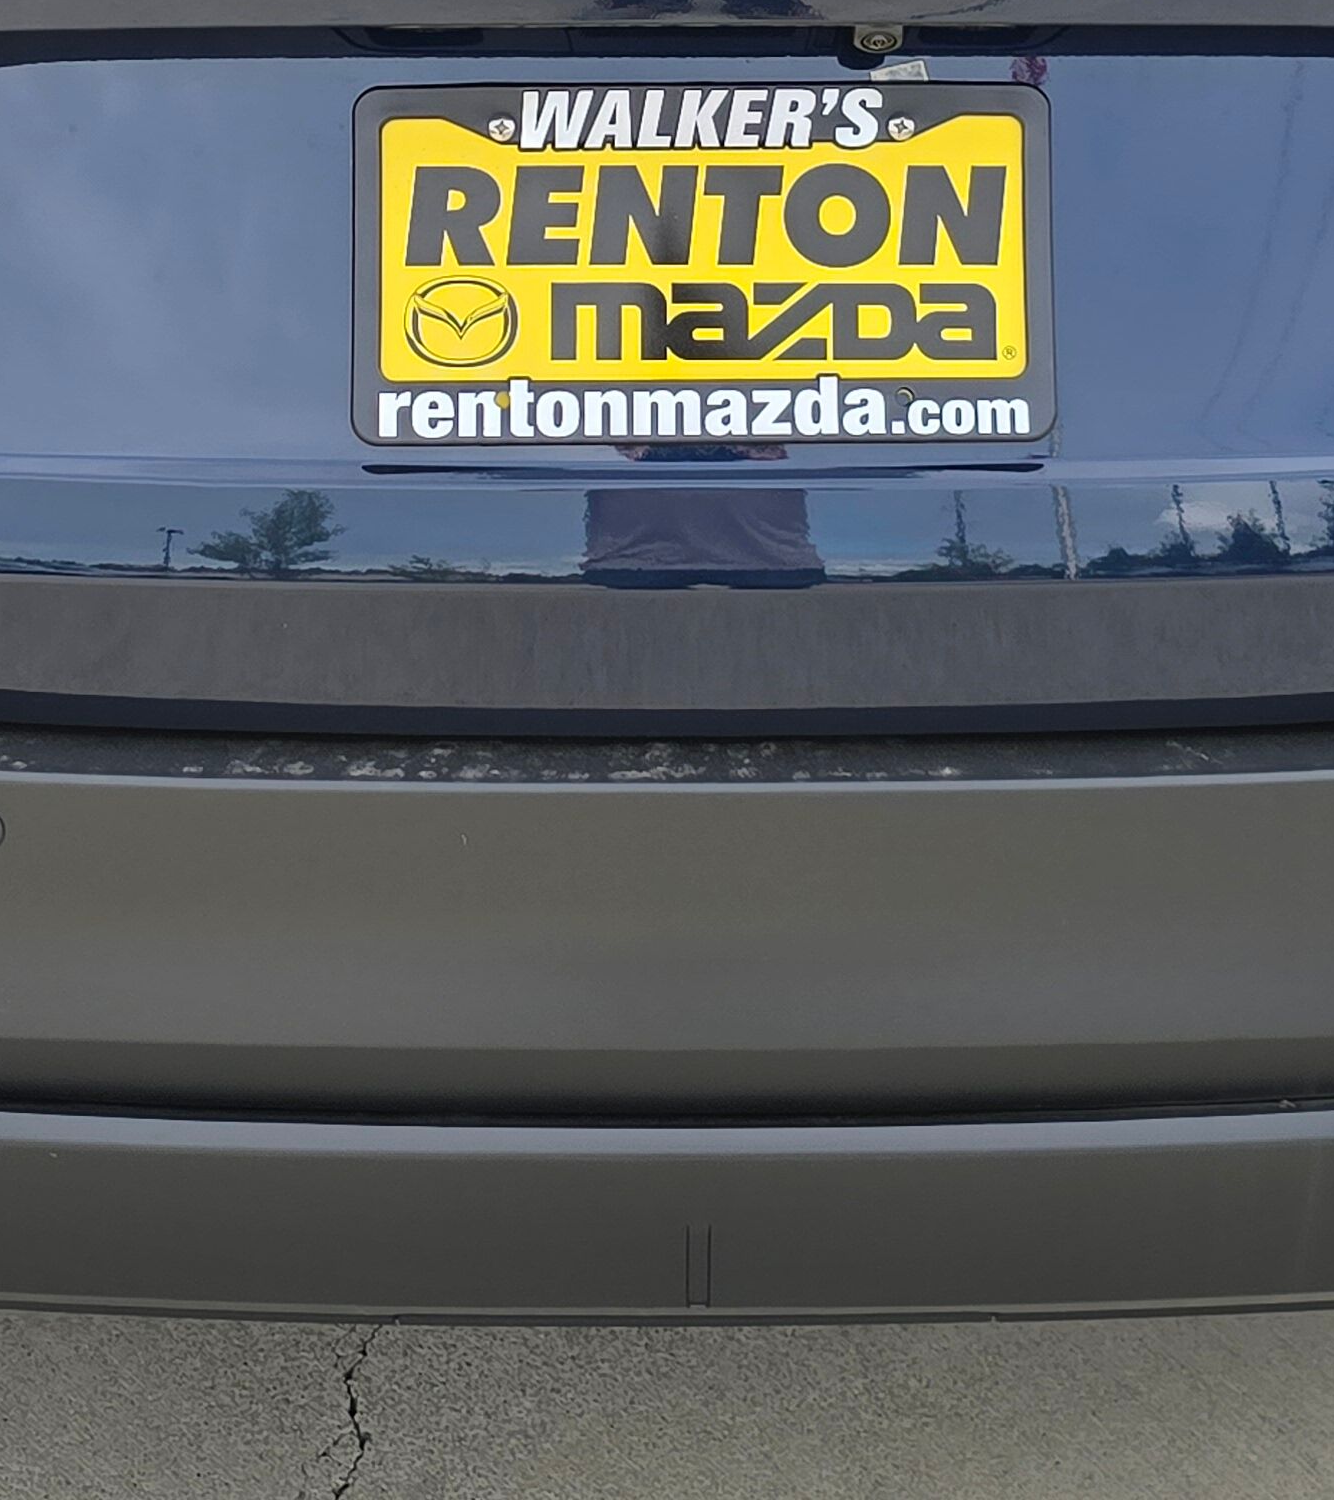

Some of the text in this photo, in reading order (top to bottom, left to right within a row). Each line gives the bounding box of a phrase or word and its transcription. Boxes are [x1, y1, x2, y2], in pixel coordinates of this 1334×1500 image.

[519, 88, 884, 150] WALKER'S
[404, 164, 1007, 267] RENTON
[378, 375, 1031, 438] rentonmazda.com
